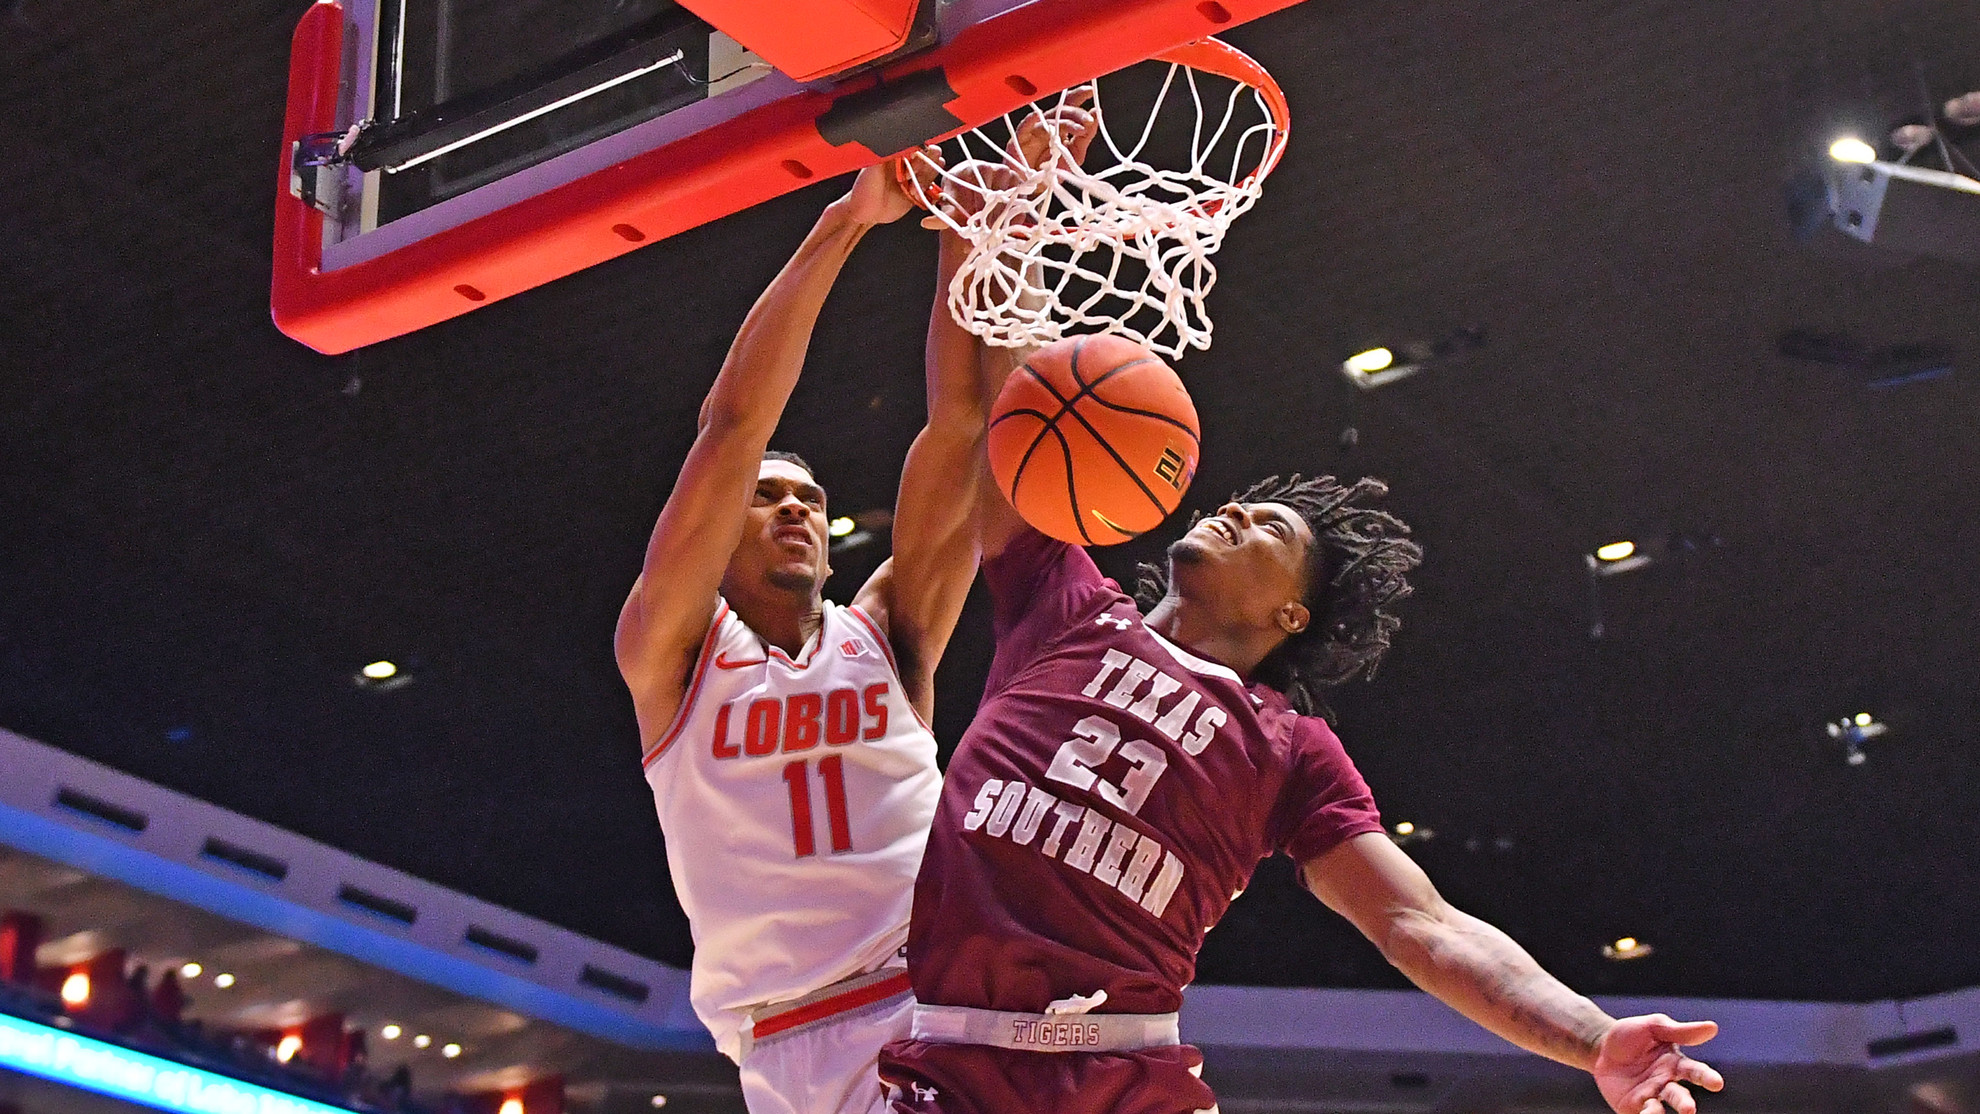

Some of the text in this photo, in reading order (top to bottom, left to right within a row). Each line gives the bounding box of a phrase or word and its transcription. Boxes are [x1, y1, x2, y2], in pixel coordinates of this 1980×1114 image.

[711, 682, 889, 760] LOBOS
[1081, 648, 1228, 756] TEXAS
[782, 753, 853, 858] 11
[1044, 714, 1168, 816] 23
[964, 778, 1185, 919] SOUTHERN
[1013, 1019, 1100, 1046] TIGERS
